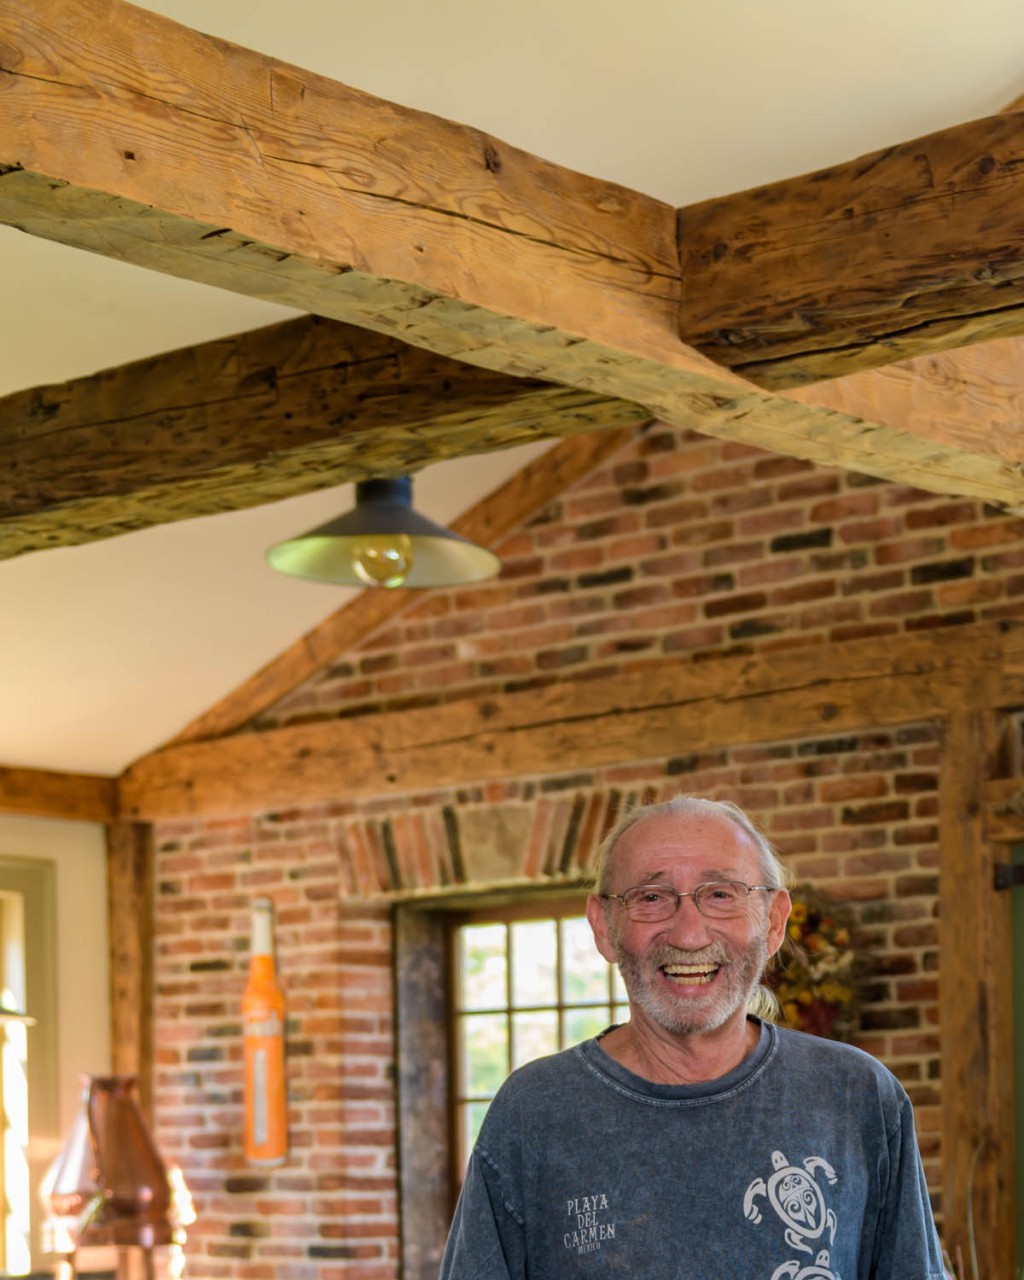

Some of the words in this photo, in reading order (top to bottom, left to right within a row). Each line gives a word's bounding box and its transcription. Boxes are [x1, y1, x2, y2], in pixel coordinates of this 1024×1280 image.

[567, 1194, 608, 1215] PLAYA
[577, 1211, 599, 1229] DEL
[563, 1224, 616, 1249] CARMEN
[578, 1242, 601, 1255] MEXICO
